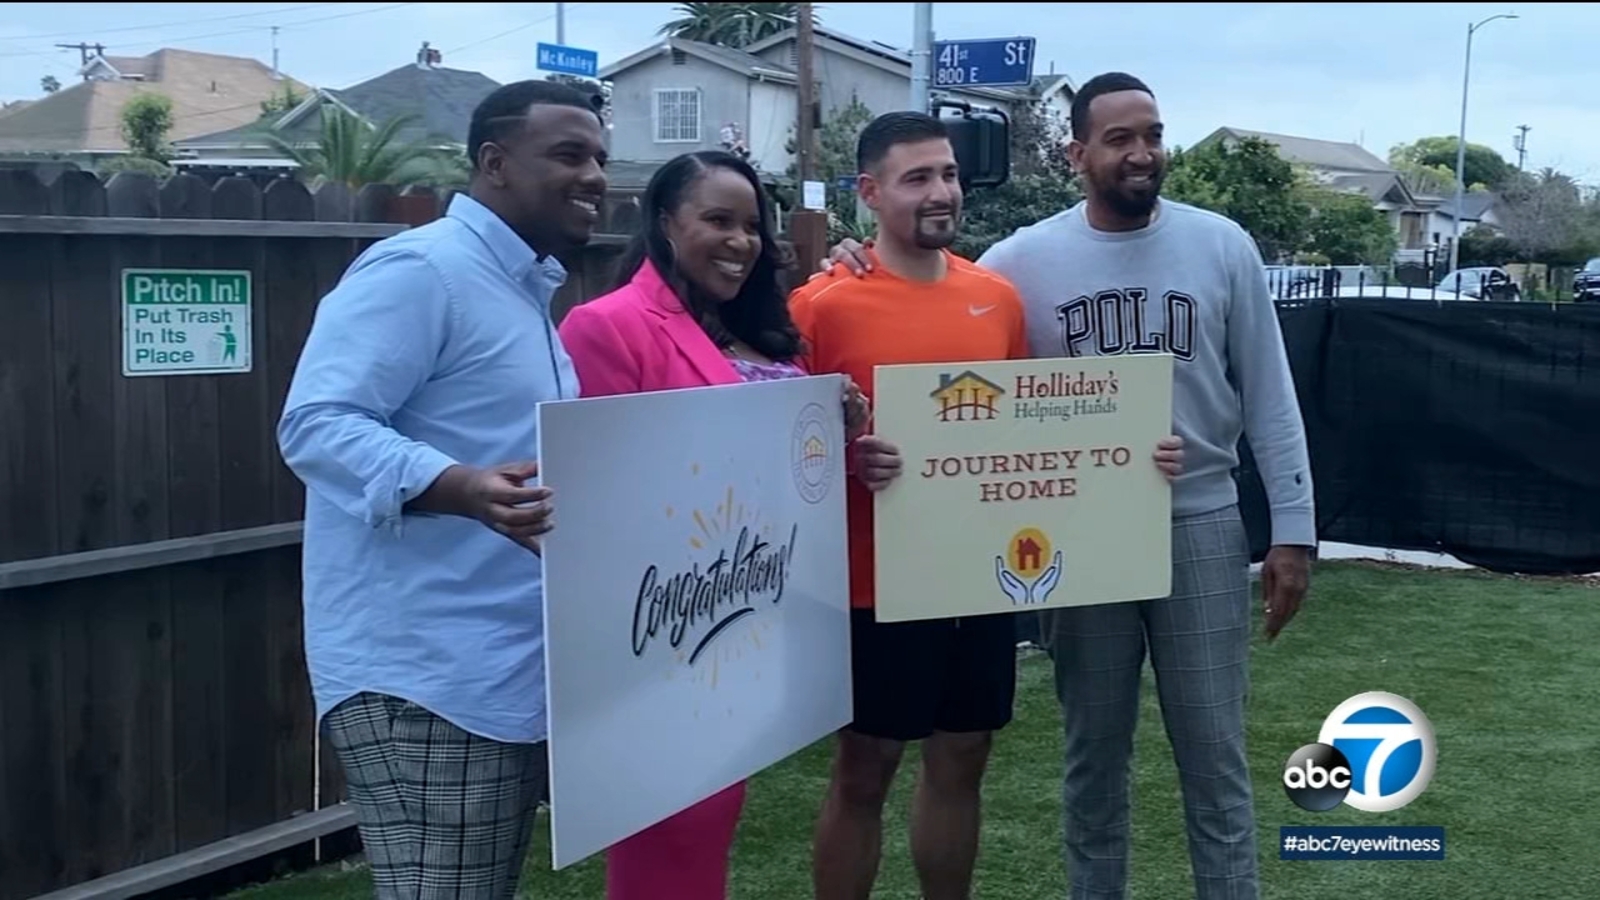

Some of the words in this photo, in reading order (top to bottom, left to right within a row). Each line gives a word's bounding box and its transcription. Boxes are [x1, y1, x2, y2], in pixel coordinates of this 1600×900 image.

[539, 49, 594, 74] McKinley
[1004, 41, 1026, 65] St
[938, 67, 964, 84] 800
[969, 67, 979, 82] E
[134, 276, 201, 302] Pitch
[210, 278, 240, 302] In!
[135, 308, 171, 324] Put
[176, 308, 233, 323] Trash
[1055, 287, 1197, 362] POLO
[135, 329, 154, 344] In
[161, 328, 187, 343] Its
[135, 349, 195, 364] Place
[1014, 370, 1119, 399] Holliday's
[1014, 402, 1071, 422] Helping
[1073, 398, 1117, 416] Hands
[921, 450, 1082, 478] JOURNEY
[1091, 447, 1131, 467] TO
[979, 477, 1077, 502] HOME
[632, 522, 799, 657] Congratulations!
